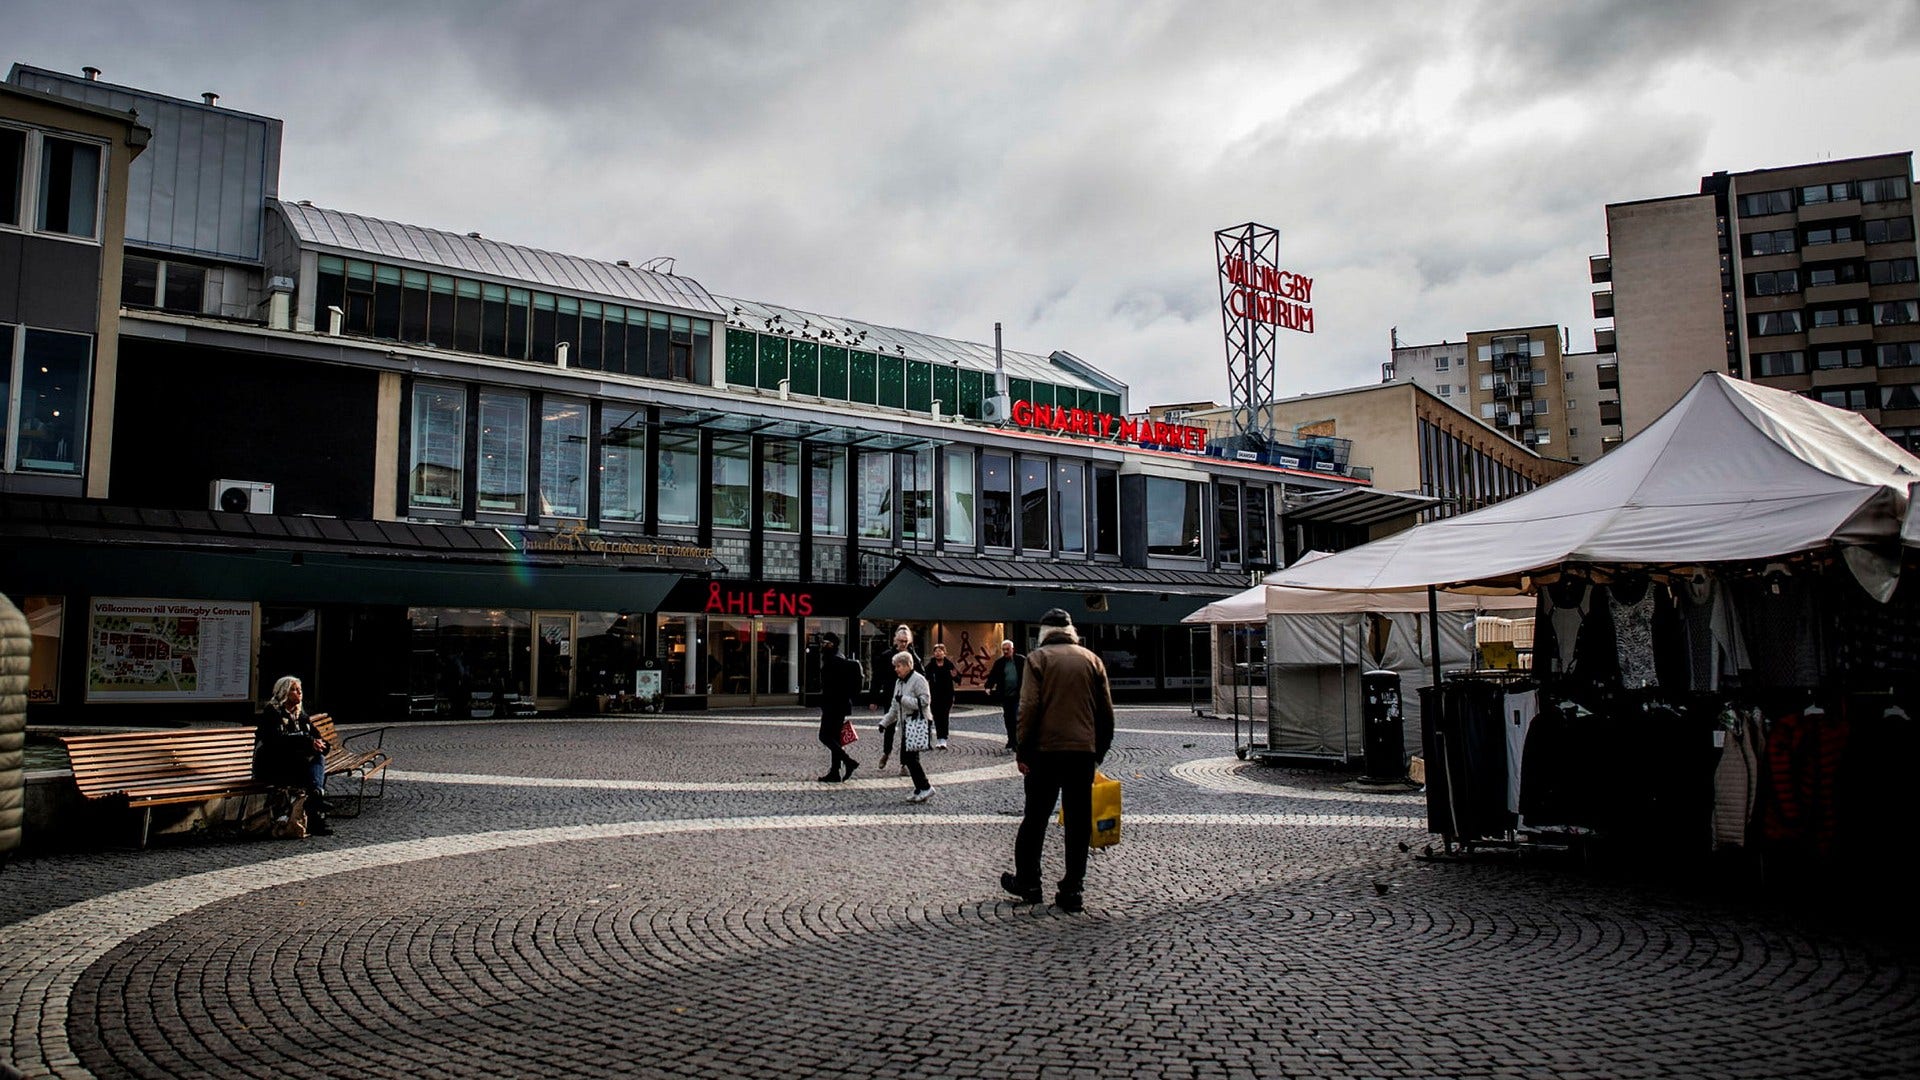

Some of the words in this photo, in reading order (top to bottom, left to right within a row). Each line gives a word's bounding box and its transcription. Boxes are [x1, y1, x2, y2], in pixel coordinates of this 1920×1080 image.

[1225, 252, 1313, 303] VÄLLINGBY
[1230, 289, 1314, 333] CENTRUM
[1012, 399, 1113, 437] GNARLY
[1119, 416, 1207, 451] MARKET
[95, 604, 152, 614] Välkommen
[154, 605, 166, 614] till
[167, 605, 211, 617] Vällingby
[212, 607, 250, 616] Centrum
[705, 581, 813, 615] ÅHLÉNS
